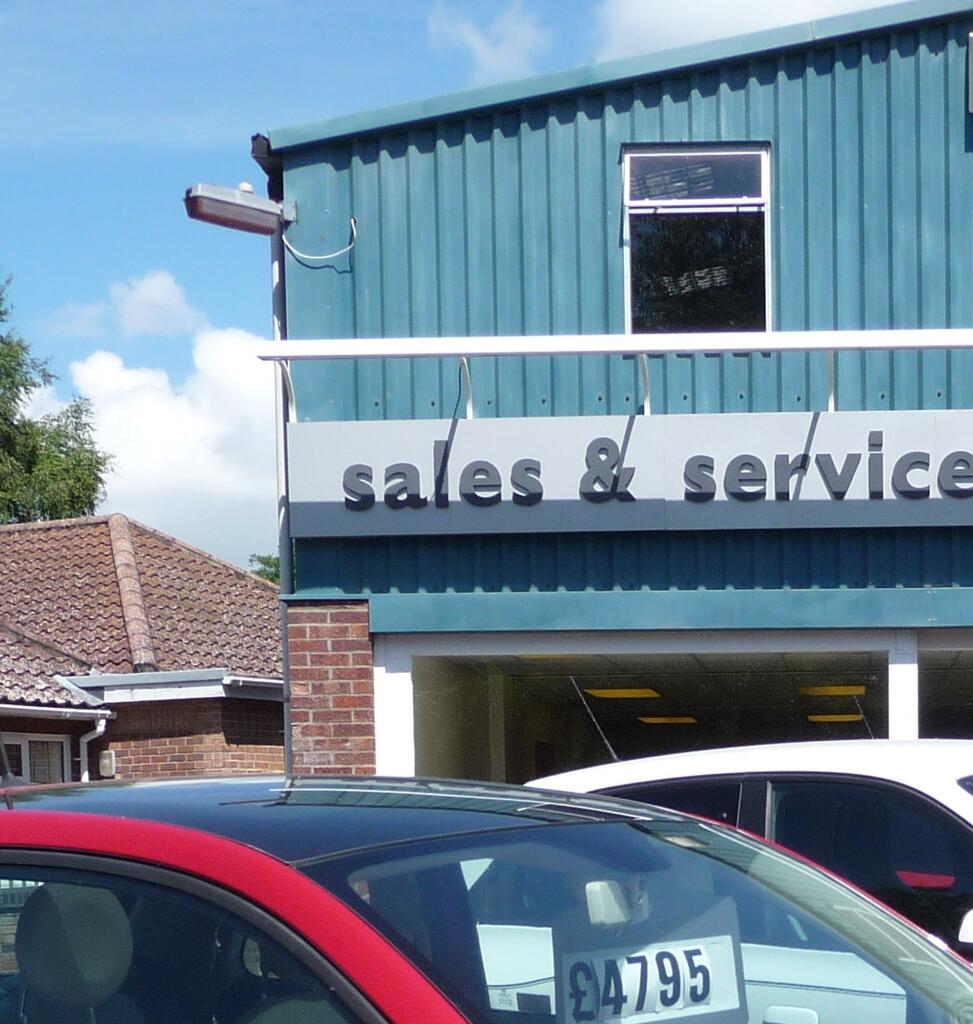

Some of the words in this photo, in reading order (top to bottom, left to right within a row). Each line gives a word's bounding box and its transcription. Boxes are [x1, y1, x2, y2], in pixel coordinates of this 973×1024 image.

[342, 439, 544, 511] sales
[578, 436, 637, 503] &
[568, 948, 711, 1023] £4795
